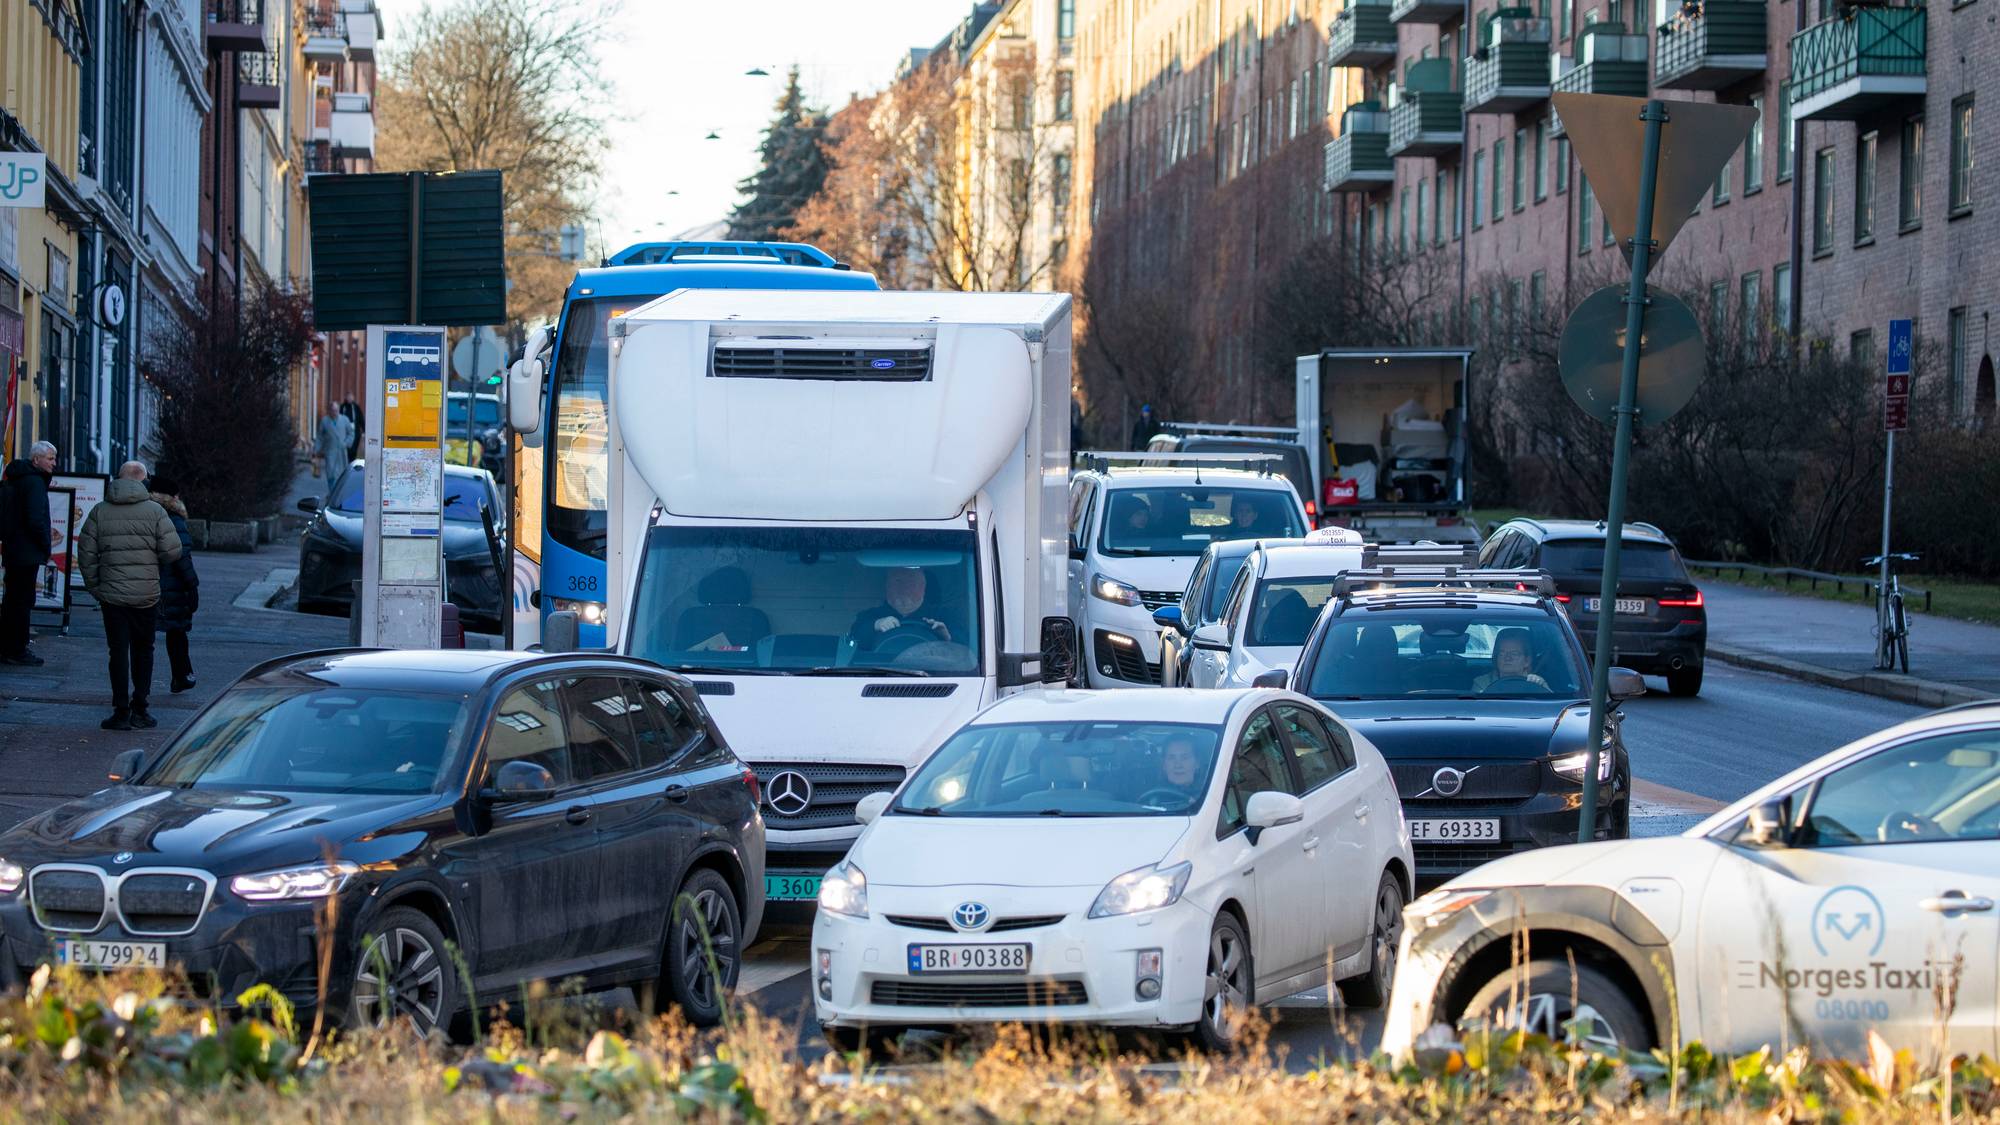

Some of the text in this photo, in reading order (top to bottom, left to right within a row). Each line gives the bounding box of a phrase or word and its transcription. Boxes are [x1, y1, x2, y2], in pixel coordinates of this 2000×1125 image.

[389, 384, 398, 392] 21
[568, 576, 597, 591] 368
[1615, 600, 1641, 611] 1359
[1411, 822, 1493, 837] EF 69333
[781, 879, 821, 895] 360
[72, 944, 90, 963] EJ
[926, 949, 950, 967] BR
[962, 948, 1024, 967] 90388
[1816, 1000, 1889, 1021] 08000
